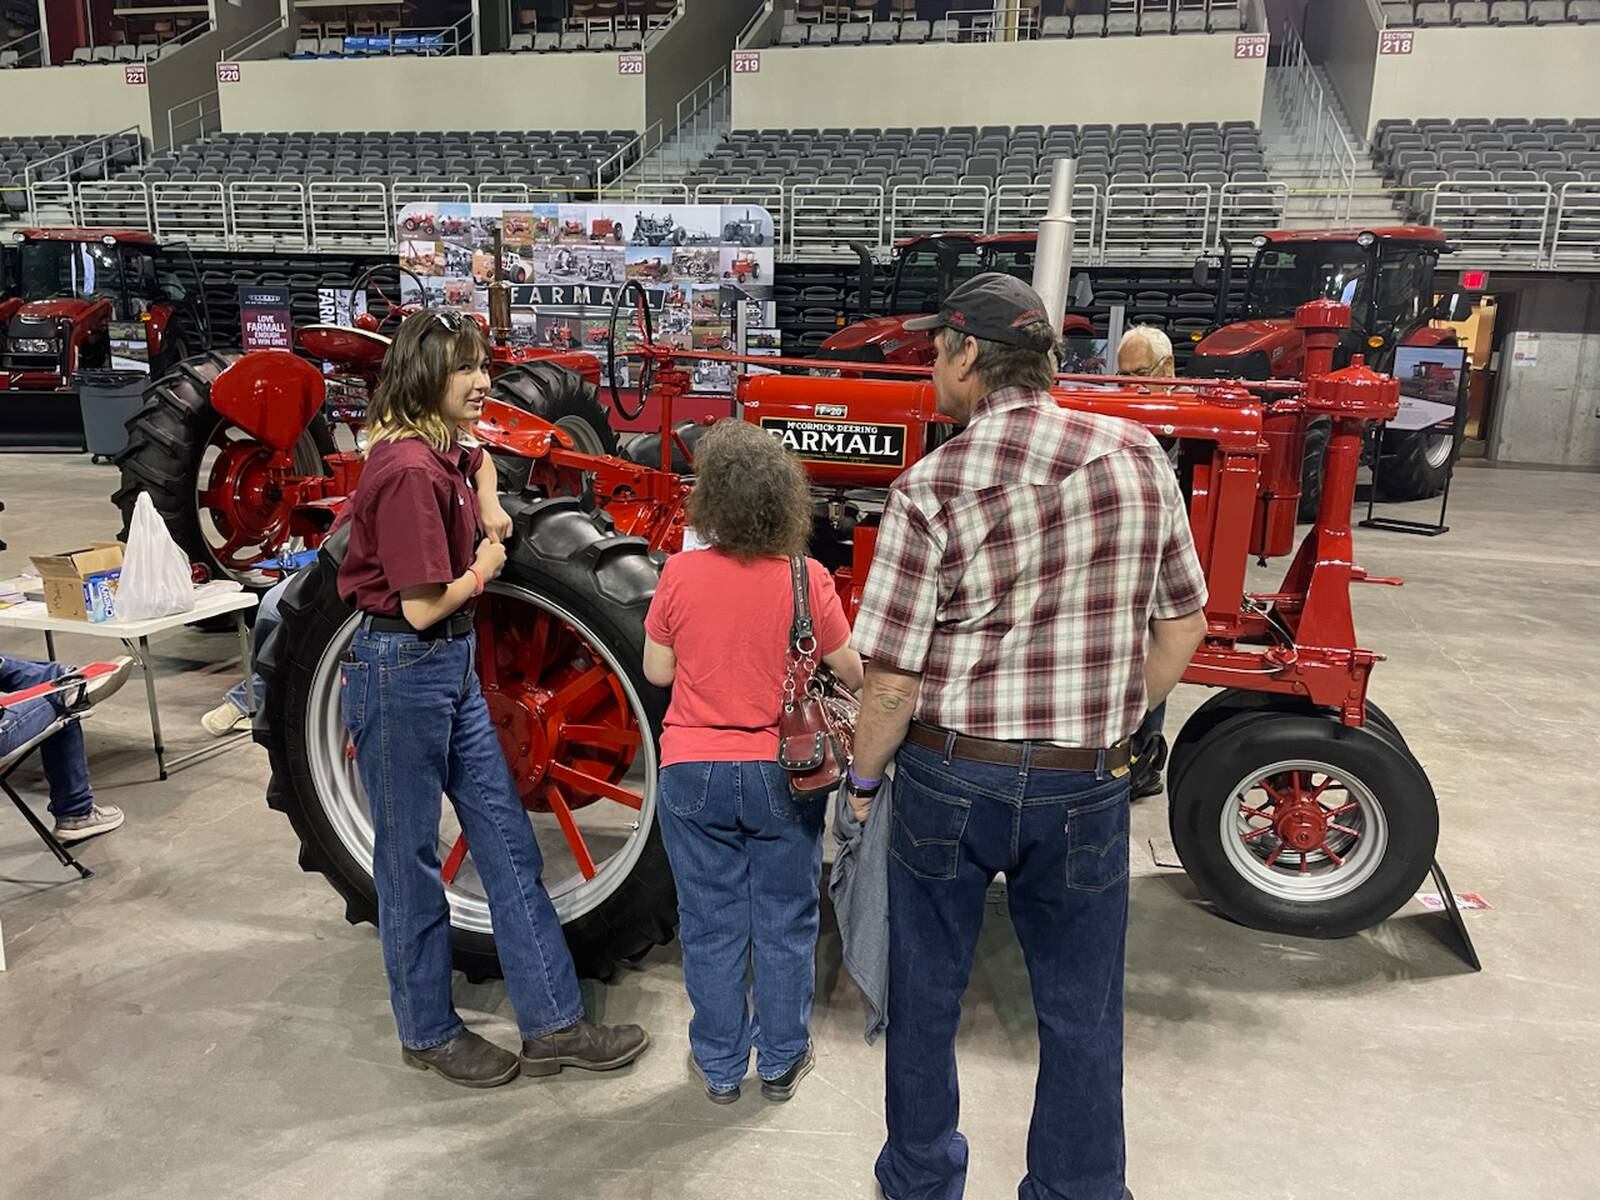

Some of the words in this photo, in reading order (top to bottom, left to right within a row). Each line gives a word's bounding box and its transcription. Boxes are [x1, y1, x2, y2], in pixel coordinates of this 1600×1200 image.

[1384, 32, 1412, 40] SECTION
[1236, 45, 1265, 57] 219
[1382, 41, 1412, 53] 218
[620, 62, 642, 73] 220
[735, 60, 758, 71] 219
[127, 73, 145, 83] 221
[219, 71, 239, 81] 220
[510, 286, 655, 307] FARMALL
[246, 322, 287, 332] FARMALL
